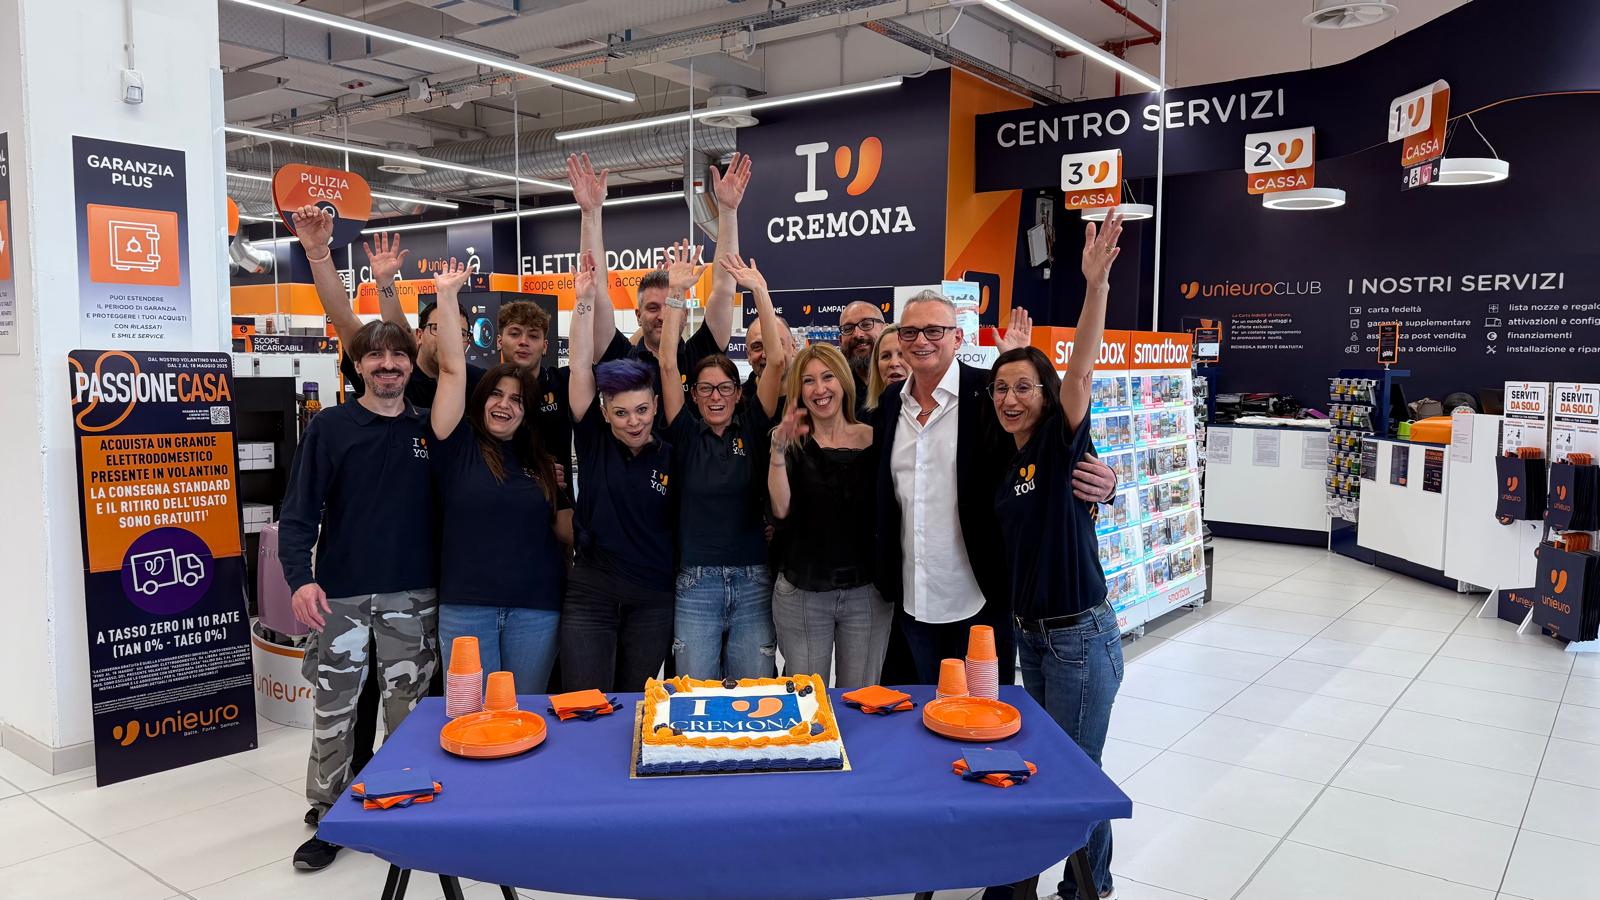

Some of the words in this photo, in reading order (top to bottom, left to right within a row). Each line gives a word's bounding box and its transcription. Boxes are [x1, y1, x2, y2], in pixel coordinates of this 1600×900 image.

[997, 109, 1130, 148] CENTRO
[1142, 88, 1284, 132] SERVIZI
[1395, 104, 1402, 132] 1
[1254, 141, 1272, 167] 2
[1406, 138, 1439, 160] CASSA
[87, 154, 174, 177] GARANZIA
[794, 141, 829, 203] I
[1068, 162, 1083, 184] 3
[112, 173, 152, 188] PLUS
[300, 172, 349, 190] PULIZIA
[1254, 173, 1308, 192] CASSA
[308, 186, 342, 200] CASA
[1070, 193, 1114, 206] CASSA
[767, 206, 916, 243] CREMONA
[524, 280, 554, 292] scope
[1202, 281, 1322, 297] unieuroCLUB
[1348, 279, 1353, 294] I
[1362, 276, 1452, 294] NOSTRI
[1461, 272, 1564, 292] SERVIZI
[1405, 318, 1471, 327] supplementare
[1508, 317, 1558, 325] attivazioni
[1411, 333, 1431, 341] post
[728, 343, 746, 351] BATT
[1134, 339, 1189, 364] smartbox
[1512, 390, 1539, 400] SERVITI
[1561, 392, 1592, 403] SERVITI
[1511, 401, 1520, 409] DA
[1521, 402, 1540, 411] SOLO
[1560, 403, 1571, 412] DA
[1572, 404, 1593, 414] SOLO
[100, 438, 154, 451] ACQUISTA
[158, 437, 172, 448] UN
[175, 436, 216, 448] GRANDE
[106, 451, 213, 466] ELETTRODOMESTICO
[92, 468, 150, 483] PRESENTE
[153, 468, 163, 479] IN
[168, 464, 228, 479] VOLANTINO
[90, 487, 106, 499] LA
[109, 483, 170, 497] CONSEGNA
[173, 479, 230, 494] STANDARD
[96, 503, 102, 514] E
[106, 502, 117, 513] IL
[120, 499, 160, 513] RITIRO
[163, 494, 227, 509] DELL'USATO
[119, 515, 150, 528] SONO
[1516, 596, 1534, 608] unieur
[1542, 595, 1570, 614] unieuro
[97, 632, 105, 644] A
[108, 625, 147, 643] TASSO
[150, 620, 179, 637] ZERO
[182, 618, 194, 630] IN
[197, 615, 210, 628] 10
[213, 611, 240, 626] RATE
[113, 641, 142, 658] (TAN
[145, 637, 164, 652] 0%
[174, 632, 202, 649] TAEG
[205, 626, 227, 643] 0%)
[256, 673, 312, 702] unieur
[688, 700, 710, 716] I
[145, 704, 239, 737] unieuro
[670, 718, 802, 732] CREMONA
